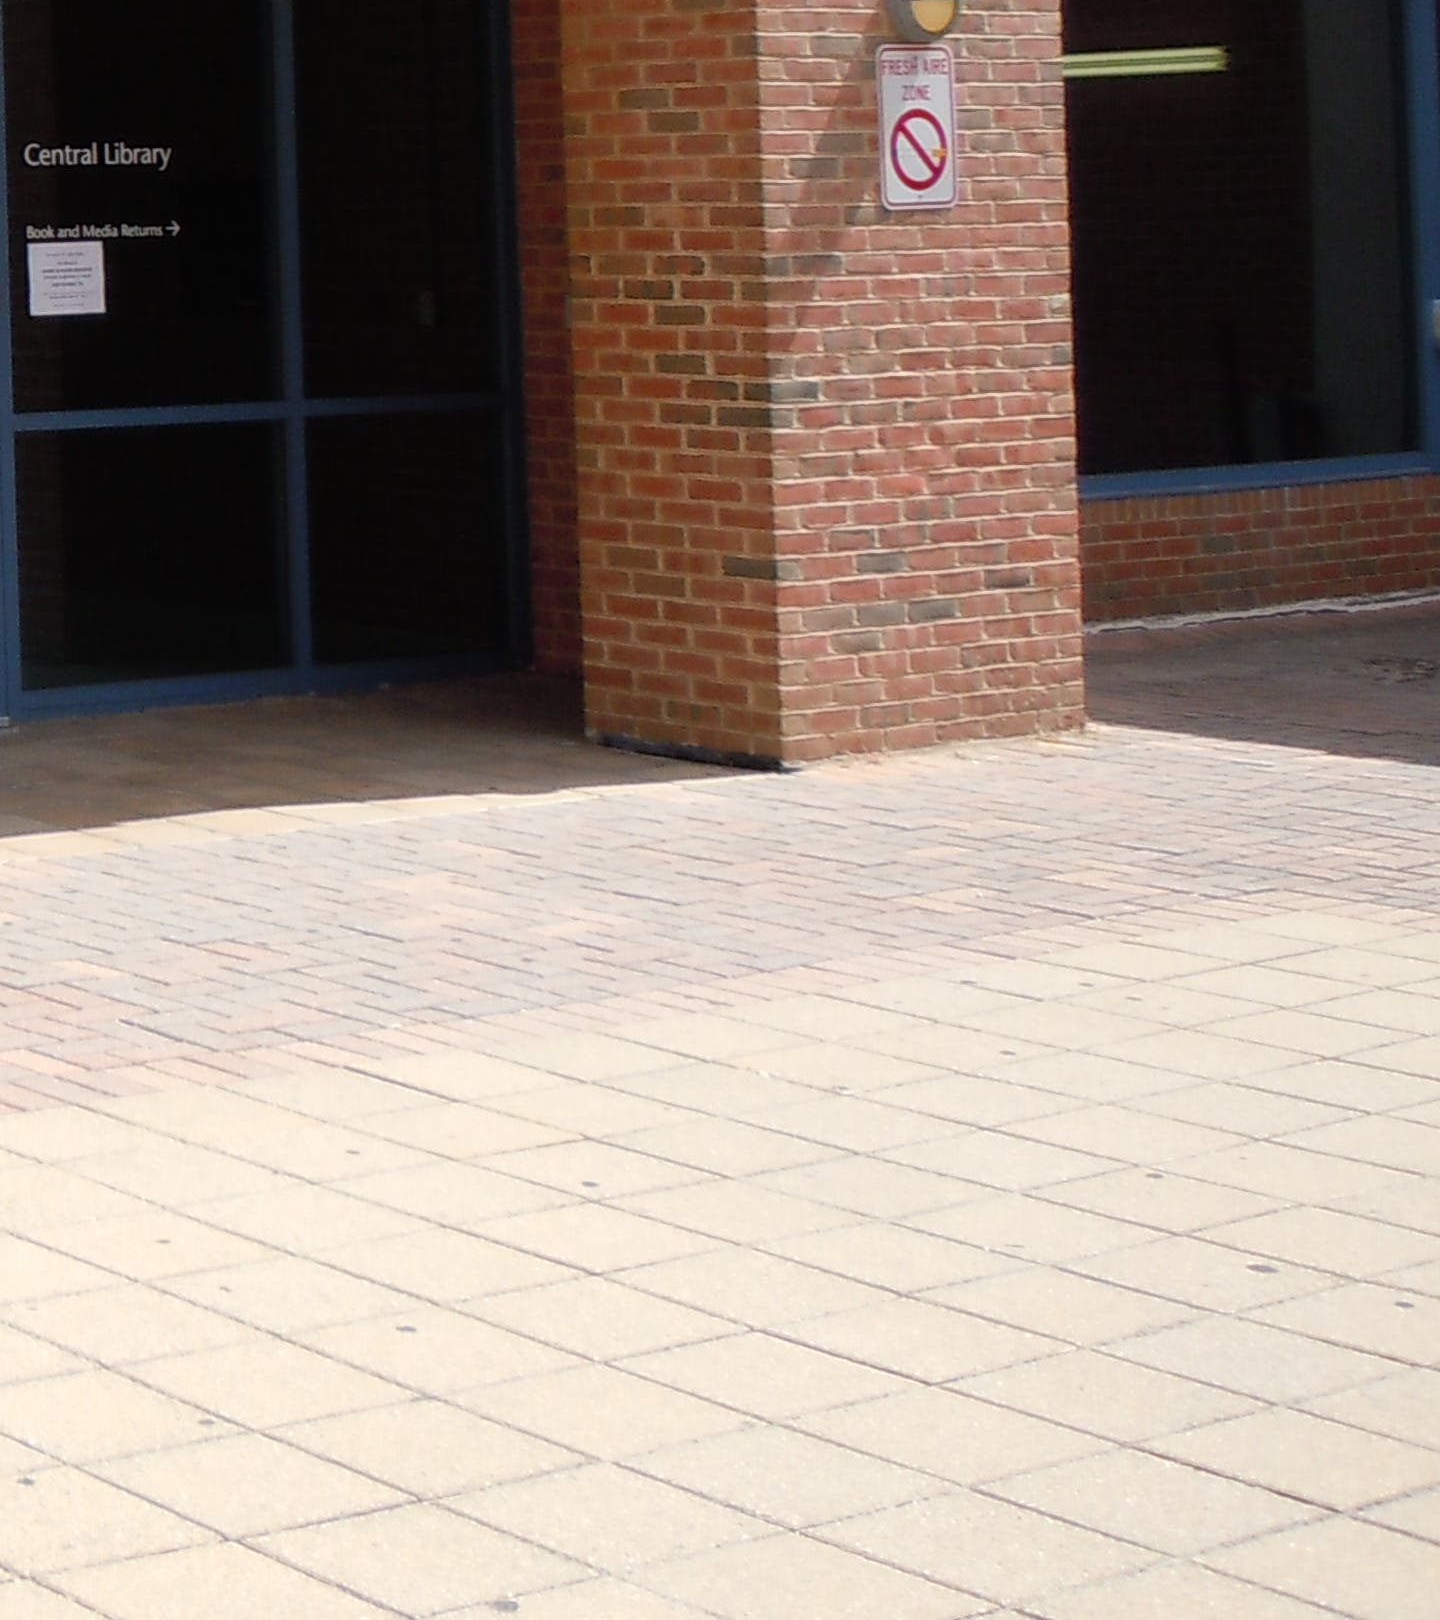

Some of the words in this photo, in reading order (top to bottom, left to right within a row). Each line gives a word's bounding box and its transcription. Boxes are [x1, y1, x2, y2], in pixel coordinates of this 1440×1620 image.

[880, 59, 918, 76] FRESH
[901, 85, 932, 101] ZONE
[24, 141, 98, 167] Central
[104, 141, 172, 172] Library
[26, 224, 56, 239] Book
[57, 224, 80, 238] and
[82, 223, 119, 238] Media
[120, 223, 164, 237] Returns
